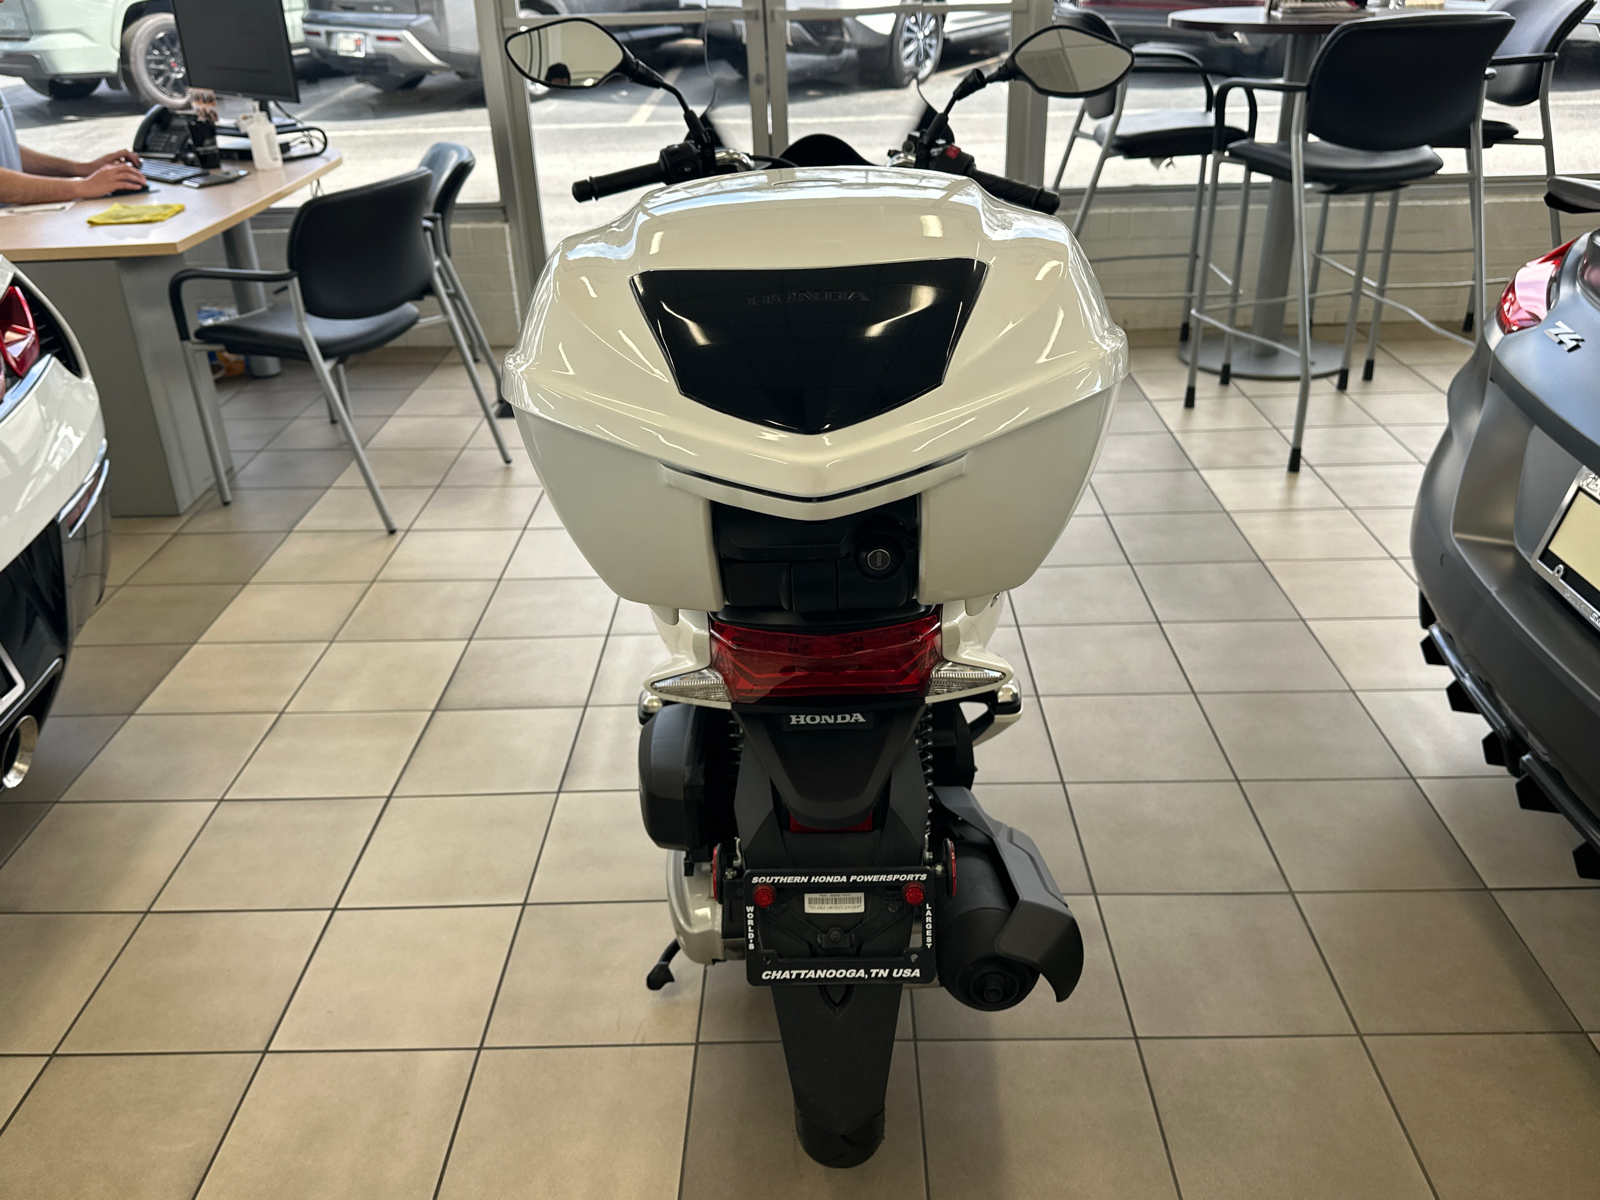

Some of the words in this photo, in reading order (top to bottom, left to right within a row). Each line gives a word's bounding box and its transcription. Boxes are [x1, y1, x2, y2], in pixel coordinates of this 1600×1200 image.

[746, 290, 871, 306] HONDA
[1543, 320, 1584, 352] Z4
[789, 712, 867, 725] HONDA
[751, 875, 808, 884] SOUTHERN
[810, 874, 847, 883] HONDA
[849, 873, 927, 882] POWERSPORTS
[745, 906, 755, 950] WORLD'S
[925, 903, 933, 949] LARGEST
[893, 968, 921, 978] USA
